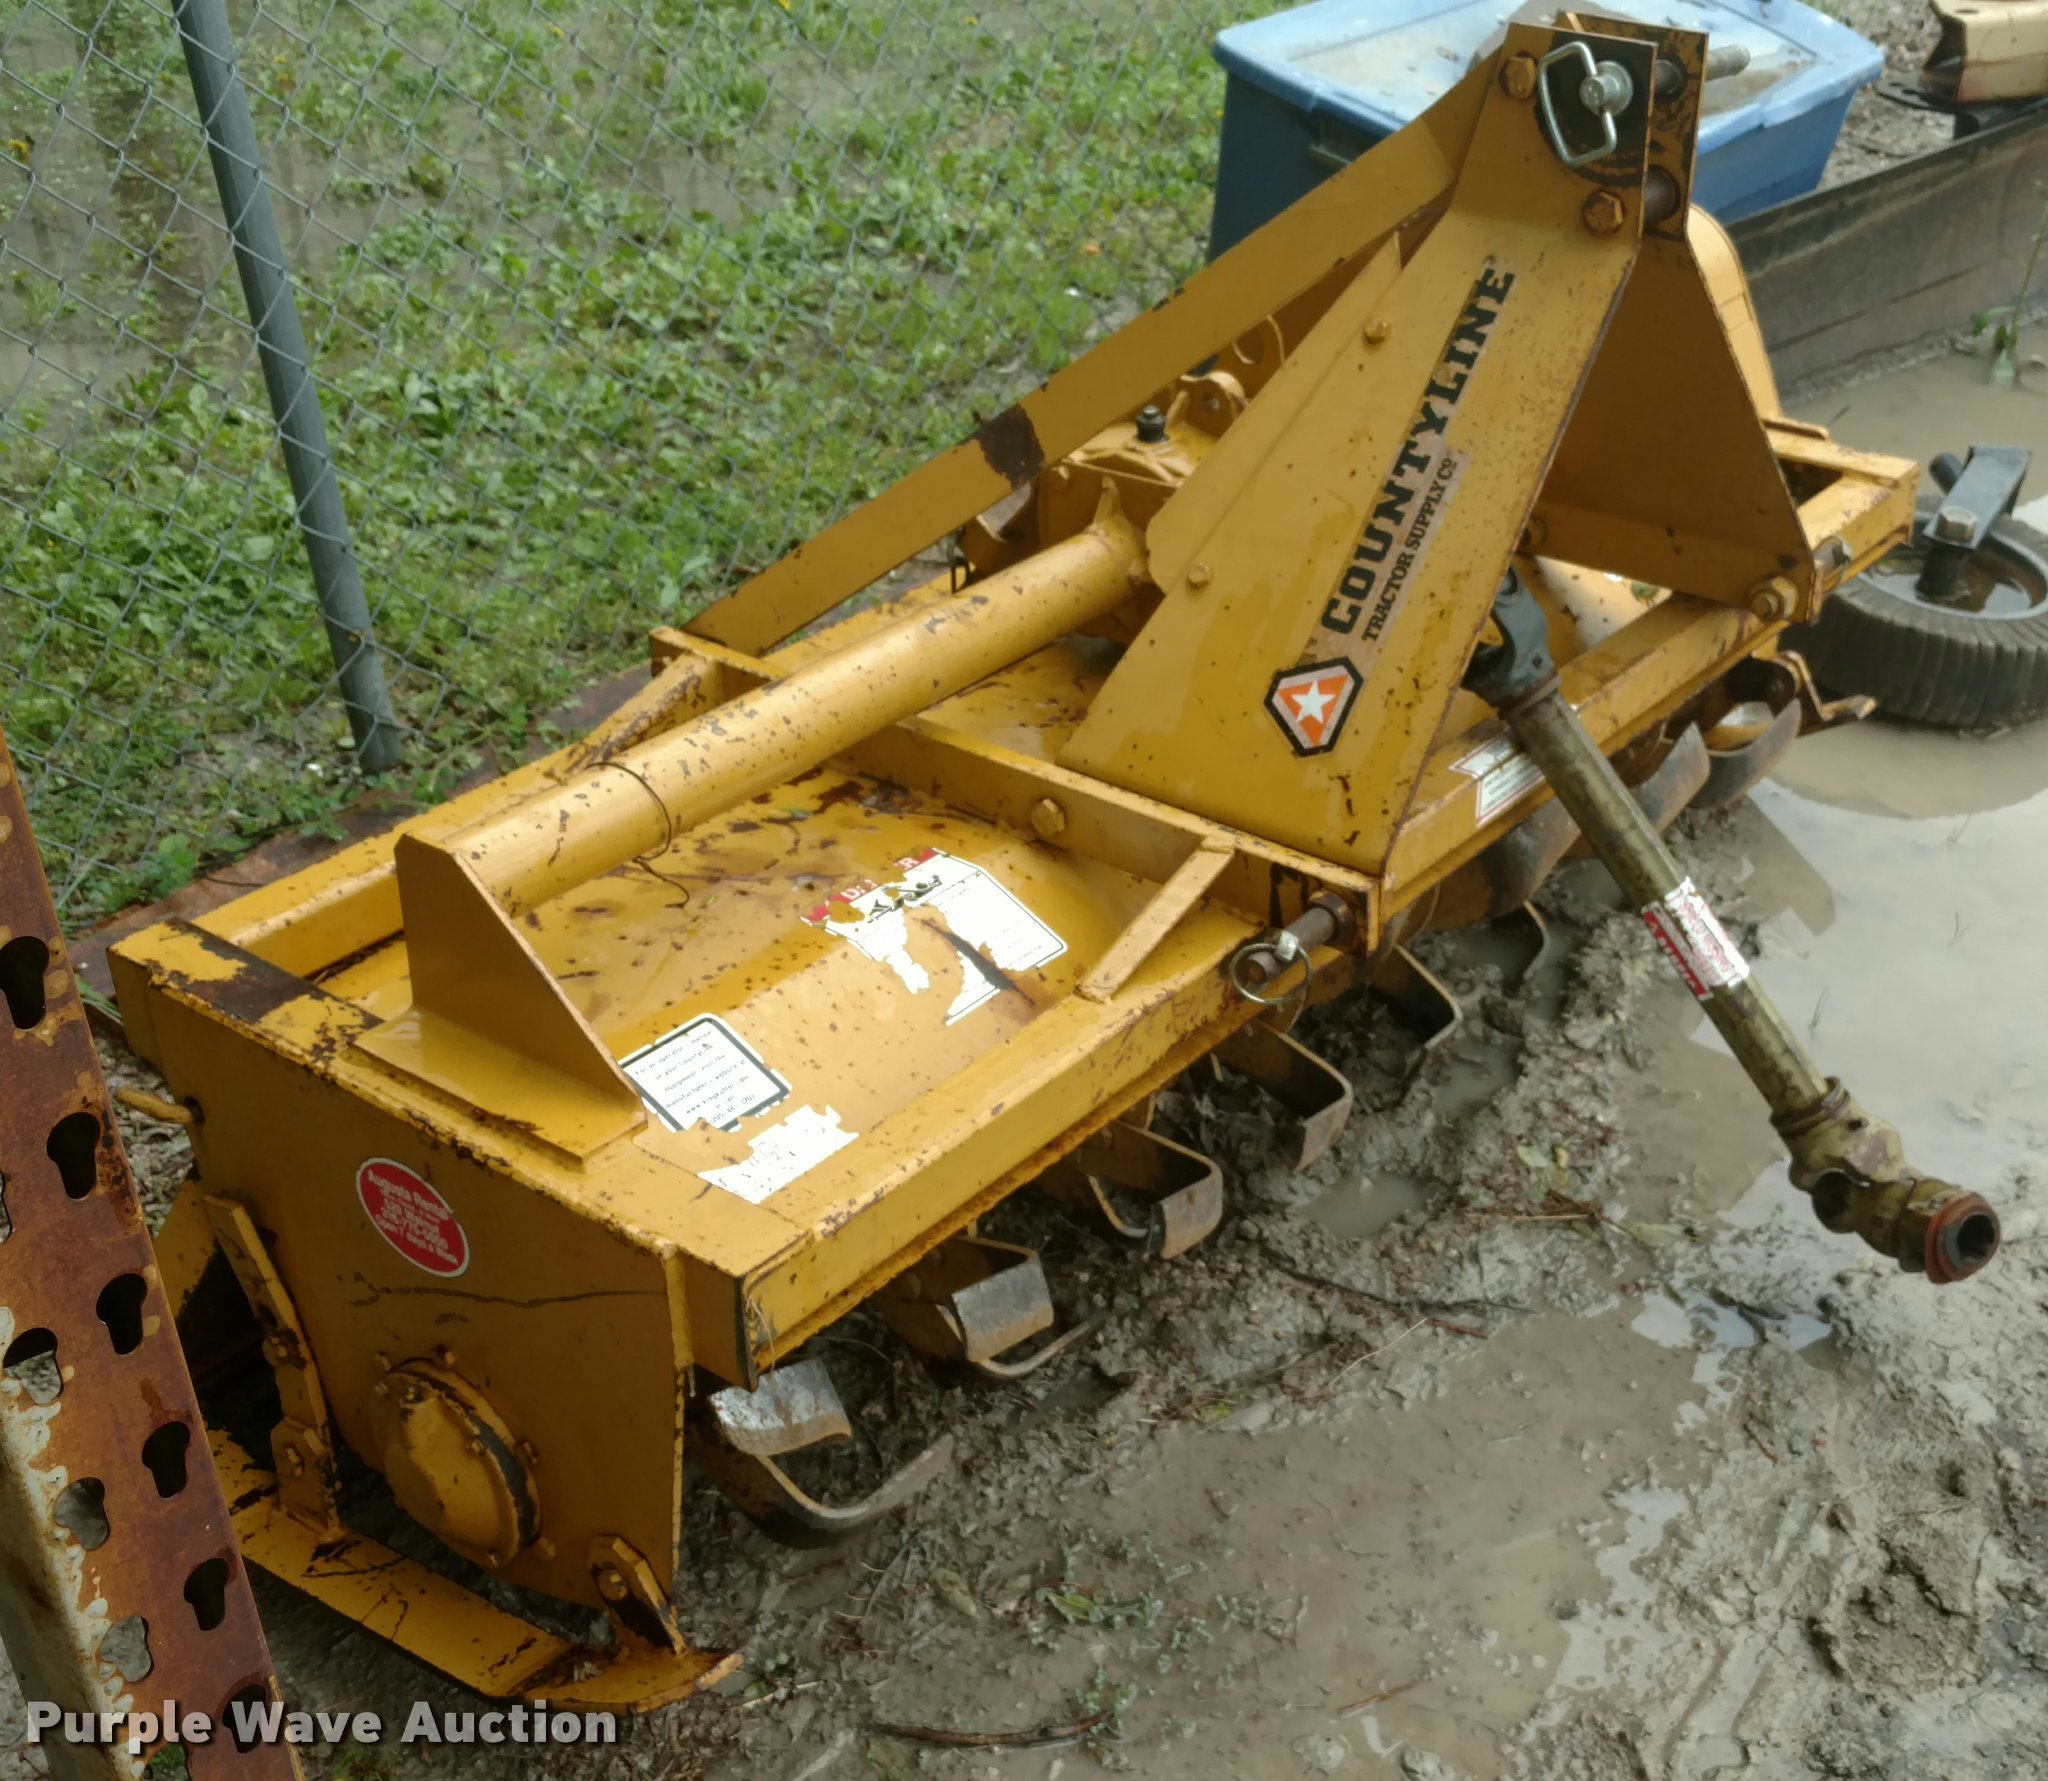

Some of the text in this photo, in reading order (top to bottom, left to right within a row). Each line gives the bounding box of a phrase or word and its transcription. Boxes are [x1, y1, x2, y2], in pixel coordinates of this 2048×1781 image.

[1321, 268, 1514, 635] COUNTYLINE
[1361, 552, 1415, 642] TRACTOR
[1404, 480, 1447, 550] SUPPLY
